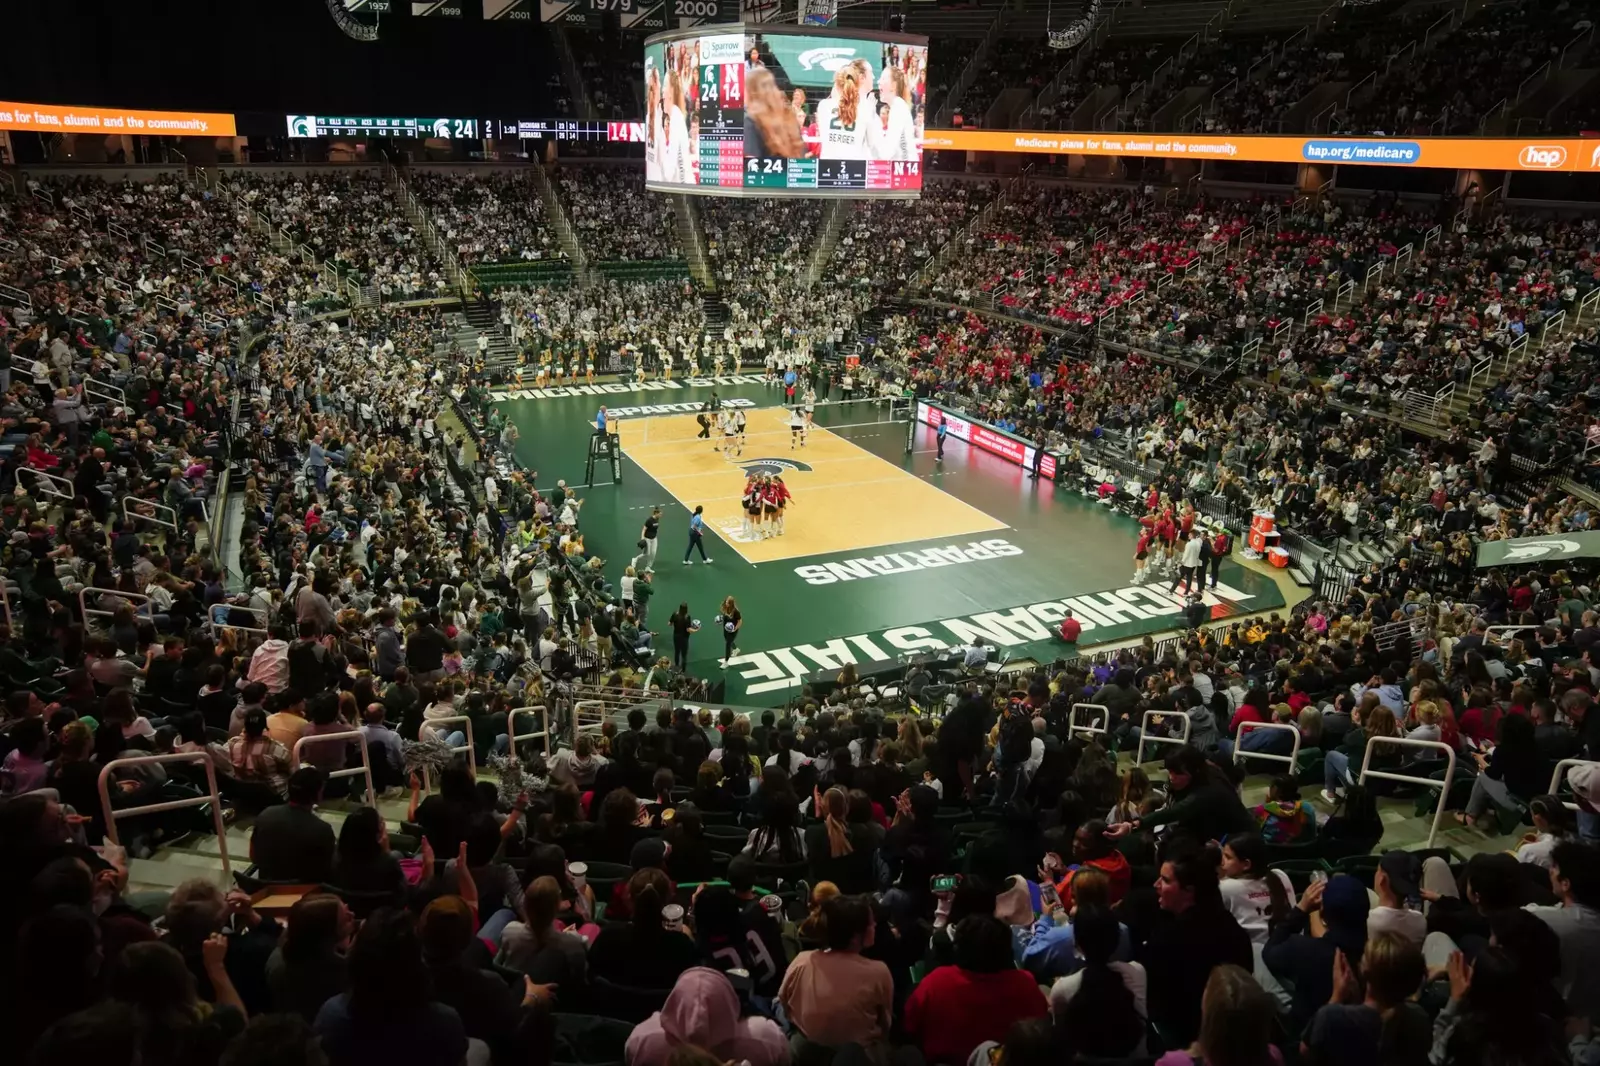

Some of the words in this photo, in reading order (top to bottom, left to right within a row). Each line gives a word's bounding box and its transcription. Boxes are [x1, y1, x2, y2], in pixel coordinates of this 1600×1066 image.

[368, 2, 389, 10] 1957
[440, 7, 461, 15] 1999
[588, 0, 631, 11] 1979
[674, 0, 718, 16] 2000
[509, 11, 530, 20] 2001
[565, 13, 586, 22] 2005
[644, 19, 663, 27] 2009
[711, 42, 739, 51] Sparrow
[702, 84, 718, 101] 24
[723, 83, 740, 101] 14
[15, 110, 30, 123] for
[34, 112, 62, 127] fans,
[64, 114, 100, 127] alumni
[104, 115, 124, 127] and
[127, 116, 144, 128] the
[147, 119, 208, 131] community.
[485, 120, 492, 132] 2
[455, 119, 473, 139] 24
[504, 126, 516, 134] 1:30
[611, 123, 627, 140] 14
[629, 123, 645, 141] N
[829, 133, 855, 144] BERGER
[1015, 138, 1058, 149] Medicare
[1060, 140, 1084, 150] plans
[1086, 140, 1100, 150] for
[1102, 141, 1123, 151] fans,
[1125, 141, 1153, 151] alumni
[1155, 142, 1170, 151] and
[1173, 142, 1186, 152] the
[1188, 143, 1237, 156] community.
[1308, 144, 1413, 161] hap.org/medicare
[1526, 147, 1560, 164] hap
[763, 159, 783, 174] 24
[840, 165, 846, 173] 2
[894, 161, 904, 176] N
[906, 162, 919, 176] 14
[490, 379, 682, 401] MICHIGAN
[793, 539, 1024, 585] SPARTANS
[939, 574, 1256, 647] MICHIGAN
[717, 625, 950, 695] STATE
